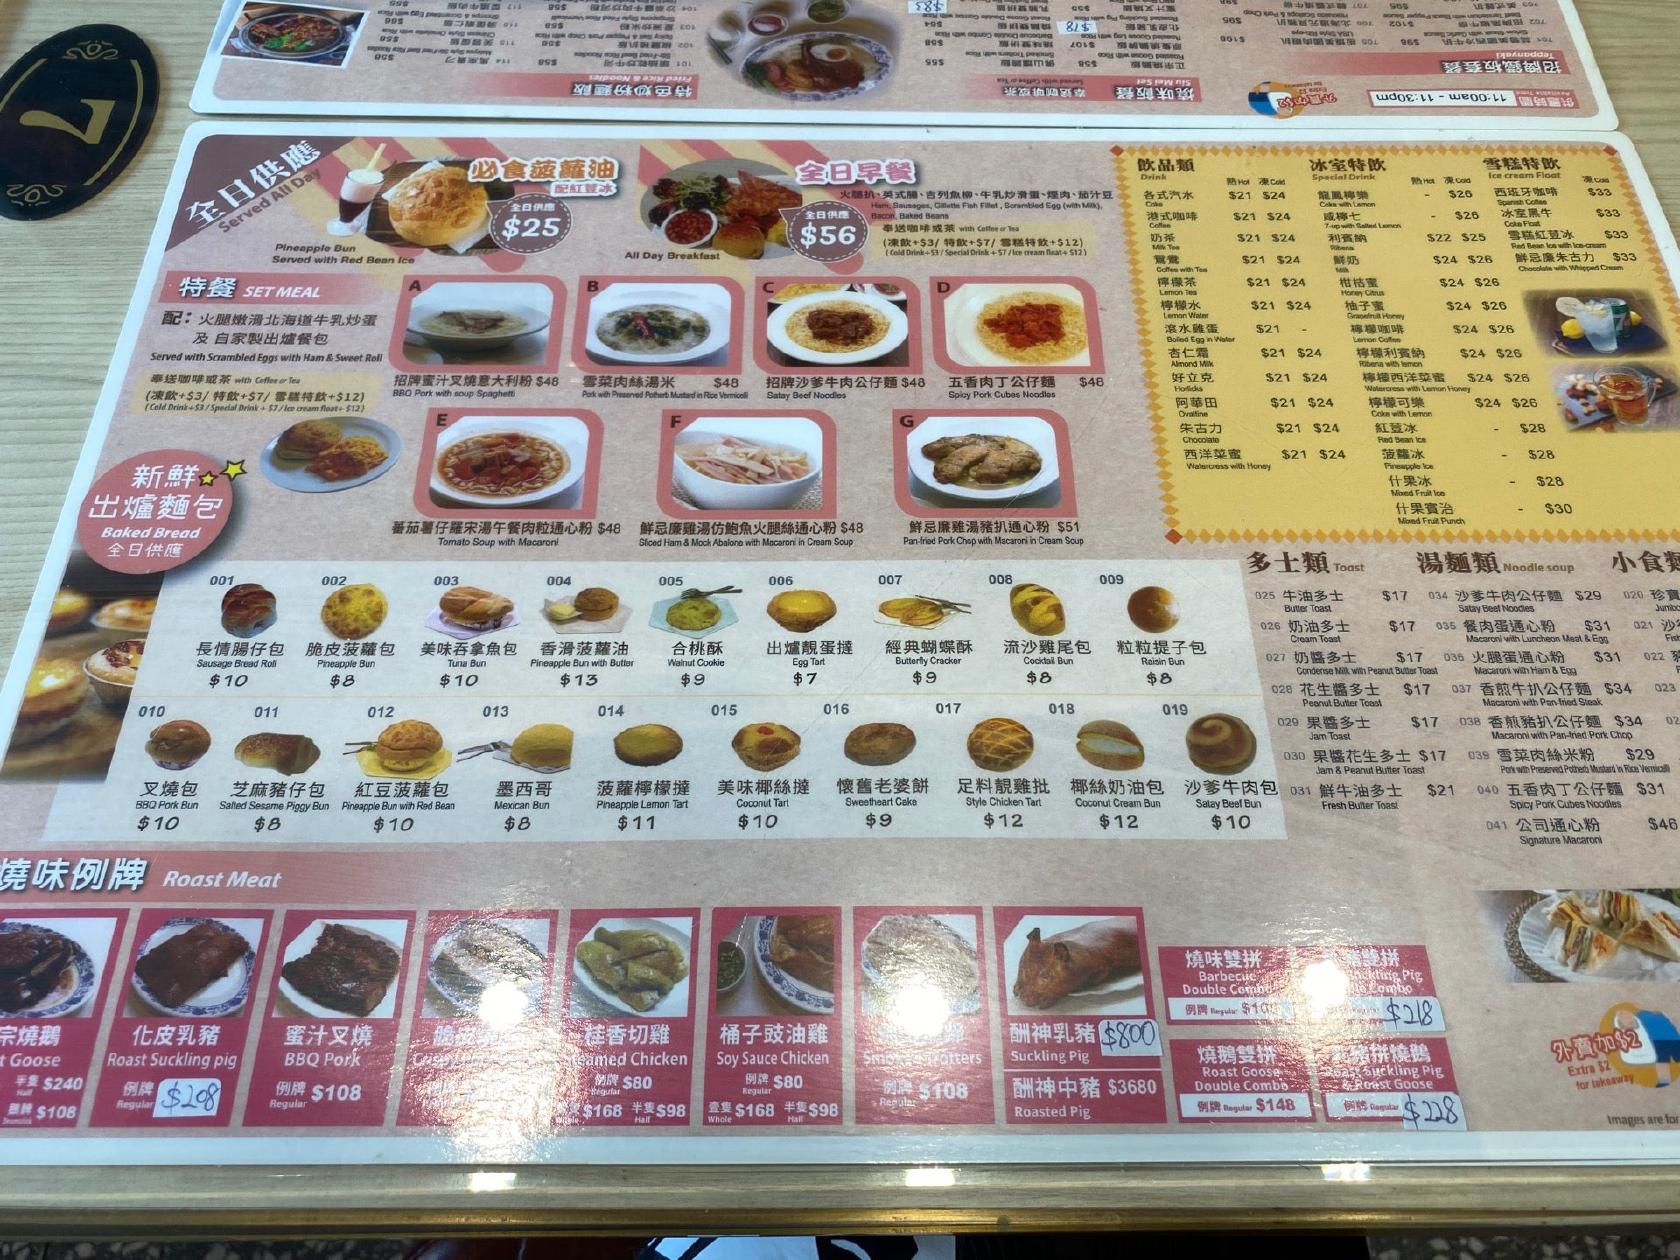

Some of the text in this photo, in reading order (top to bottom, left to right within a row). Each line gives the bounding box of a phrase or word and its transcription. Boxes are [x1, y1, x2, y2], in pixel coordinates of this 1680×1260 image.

[1065, 22, 1090, 33] $78
[19, 98, 116, 145] 7
[795, 159, 915, 185] 全日早餐
[1137, 158, 1194, 173] 飲品類
[1309, 158, 1387, 173] 冰室特飲
[1141, 173, 1167, 181] Drink
[1312, 173, 1376, 182] Special Drink
[185, 139, 321, 232] 全日供應
[1587, 187, 1612, 197] $33
[218, 169, 321, 233] Served All Day
[510, 203, 556, 213] 全日供應
[806, 209, 850, 221] 全日供應
[501, 217, 561, 239] $25
[800, 223, 856, 246] $56
[275, 243, 356, 254] Pineapple Bun
[272, 256, 415, 264] Served with Red Bean Ice
[624, 252, 720, 262] All Day Breakfast
[179, 277, 321, 298] 特餐 SET MEAL
[408, 280, 422, 291] A
[587, 280, 599, 292] B
[762, 281, 775, 294] C
[937, 281, 950, 293] D
[199, 312, 376, 328] 火腿嫩滑北海道牛乳炒蛋
[150, 352, 181, 362] Served
[183, 352, 205, 362] with
[207, 352, 254, 362] Scrambled
[256, 352, 278, 364] Eggs
[280, 352, 300, 362] with
[303, 352, 325, 362] Ham
[336, 352, 366, 362] Sweet
[368, 352, 383, 362] Roll
[393, 374, 559, 388] 招牌蜜汁叉燒意大利粉 $48
[713, 377, 739, 389] $48
[901, 377, 926, 389] $48
[948, 376, 1105, 389] 五香肉丁公仔麵 $48
[436, 414, 447, 426] E
[670, 415, 682, 428] F
[900, 414, 914, 428] G
[1282, 449, 1307, 460] $21
[1320, 449, 1346, 460] $24
[1186, 463, 1228, 471] Watercress
[1245, 463, 1271, 471] Honey
[131, 464, 196, 489] 新鮮
[88, 493, 222, 521] 出爐麵包
[1545, 503, 1573, 515] $30
[1057, 521, 1080, 533] $51
[1398, 517, 1465, 525] Mixed Fruit Punch
[101, 527, 200, 539] Baked Bread
[598, 523, 620, 534] $48
[840, 522, 864, 535] $48
[106, 542, 183, 558] 全日供應
[1246, 551, 1365, 574] 多士類 Toast
[1416, 551, 1575, 574] 湯麵類 Noodle soup
[768, 576, 794, 586] 006
[1282, 589, 1408, 603] 牛油多士 $17
[196, 641, 284, 657] 長情腸仔包
[792, 658, 825, 667] Egg Tart
[209, 674, 248, 687] $10
[793, 672, 818, 685] $7
[138, 706, 165, 718] 010
[1162, 704, 1188, 716] 019
[140, 781, 199, 798] 叉燒包
[1184, 780, 1278, 795] 沙爹牛肉包
[1196, 799, 1261, 809] Satay Beef Bun
[137, 817, 179, 831] $10
[1211, 815, 1251, 829] $10
[1516, 817, 1678, 833] 公司通心粉 $46
[1520, 835, 1602, 847] Signature Macaroni
[163, 871, 225, 888] Roast
[227, 871, 282, 888] Meat
[1185, 950, 1262, 969] 燒味雙拼
[1384, 999, 1433, 1026] $218
[132, 1024, 221, 1047] 化皮乳豬
[284, 1024, 374, 1047] 蜜汁叉燒
[719, 1024, 829, 1045] 桶子豉油雞
[1101, 1019, 1155, 1048] $800
[107, 1053, 237, 1069] Roast Suckling pig
[717, 1051, 829, 1068] Soy Sauce Chicken
[1011, 1050, 1090, 1065] Suckling Pig
[311, 1085, 361, 1101] $108
[1108, 1080, 1156, 1095] $3680
[160, 1081, 220, 1115] $208
[1014, 1105, 1091, 1120] Roasted Pig
[1403, 1096, 1458, 1129] $228
